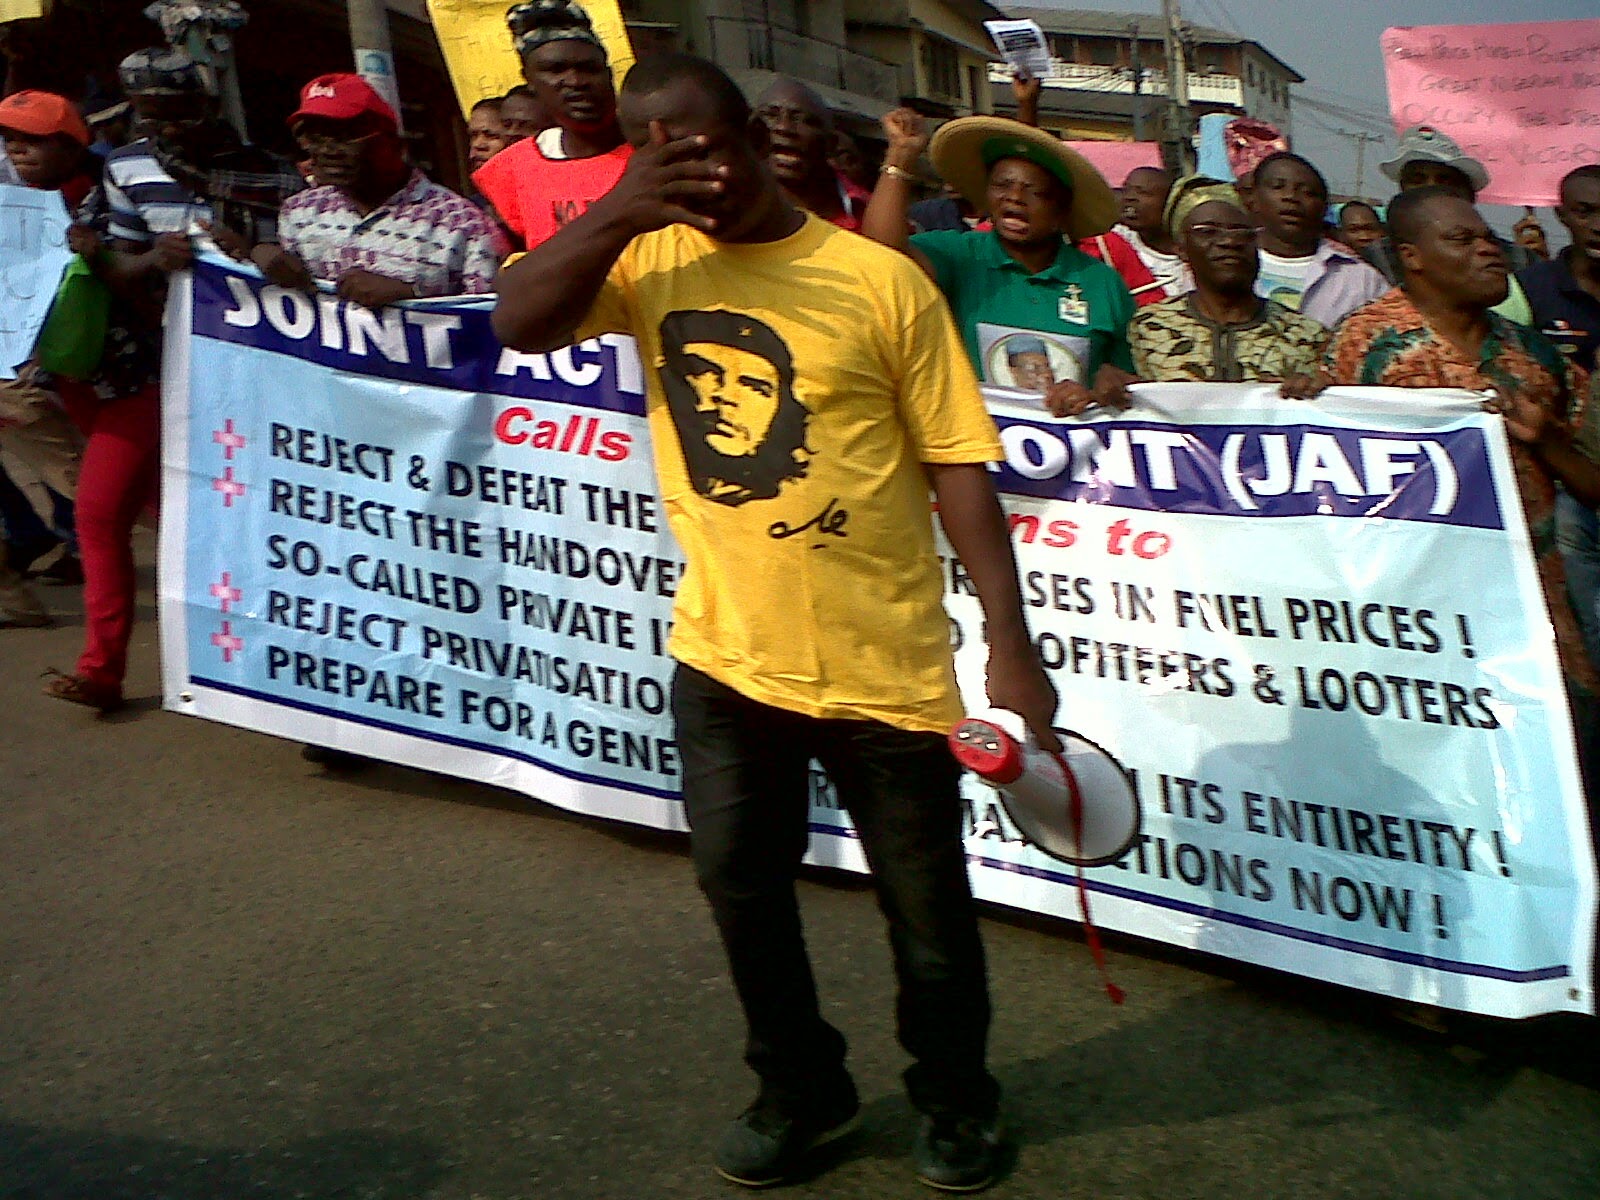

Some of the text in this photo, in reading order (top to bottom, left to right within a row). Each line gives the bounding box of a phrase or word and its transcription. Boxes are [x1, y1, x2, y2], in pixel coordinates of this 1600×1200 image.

[224, 276, 645, 395] JOINT ACT
[271, 422, 656, 533] REJECT & DEFEAT THE
[494, 406, 634, 462] Calls
[1000, 425, 1460, 516] ONT (JAF)
[270, 479, 686, 598] REJECT THE HANDOVE
[1008, 513, 1172, 560] ns to
[267, 534, 481, 614] SO-CALLED
[499, 584, 636, 650] PRIVATE
[1026, 571, 1096, 614] SES
[1111, 582, 1156, 624] IN
[1289, 597, 1441, 655] PRICES
[267, 589, 406, 652] REJECT
[422, 625, 665, 715] PRIVATISATIO
[1038, 632, 1236, 697] OFITEERS
[1253, 664, 1286, 705] &
[1298, 667, 1501, 730] LOOTERS
[267, 645, 679, 776] PREPARE FOR A GENE
[1159, 774, 1225, 824] ITS
[1242, 792, 1477, 875] ENTIREITY
[1137, 835, 1275, 903] TIONS
[1290, 868, 1413, 933] NOW
